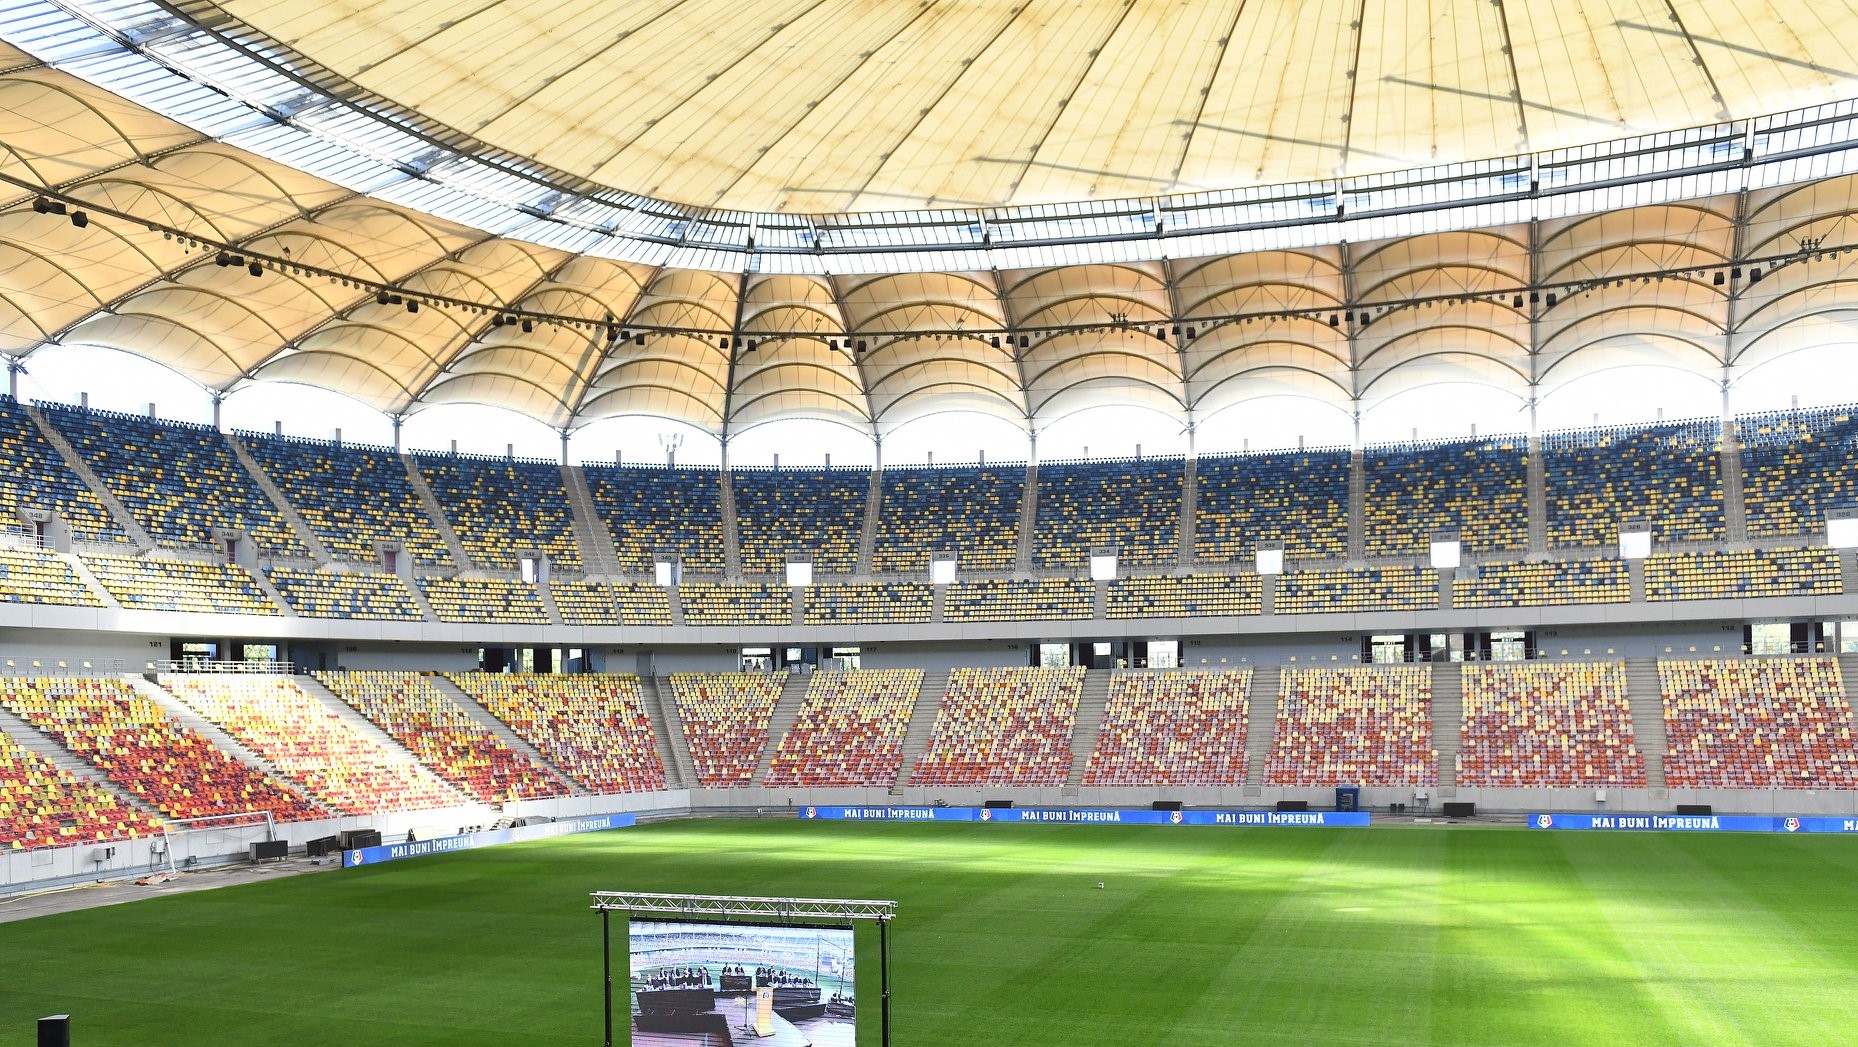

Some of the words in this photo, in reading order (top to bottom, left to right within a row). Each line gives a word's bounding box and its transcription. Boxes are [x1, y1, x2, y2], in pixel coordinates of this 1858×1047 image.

[844, 809, 861, 818] MAI
[864, 809, 885, 818] BUNI
[888, 808, 934, 819] ÎMPREUNĂ
[1022, 811, 1039, 820] MAI
[1043, 811, 1066, 820] BUNI
[1069, 810, 1120, 821] ÎMPREUNĂ
[1216, 813, 1235, 823] MAI
[1239, 813, 1265, 823] BUNI
[1268, 812, 1324, 824] ÎMPREUNĂ
[578, 817, 611, 831] ÎMPREUNĂ
[1592, 817, 1615, 828] MAI
[1619, 817, 1649, 828] BUNI
[1653, 816, 1719, 829] ÎMPREUNĂ
[391, 847, 408, 858] MAI
[410, 844, 431, 855] BUNI
[432, 836, 475, 852] ÎMPREUNĂ
